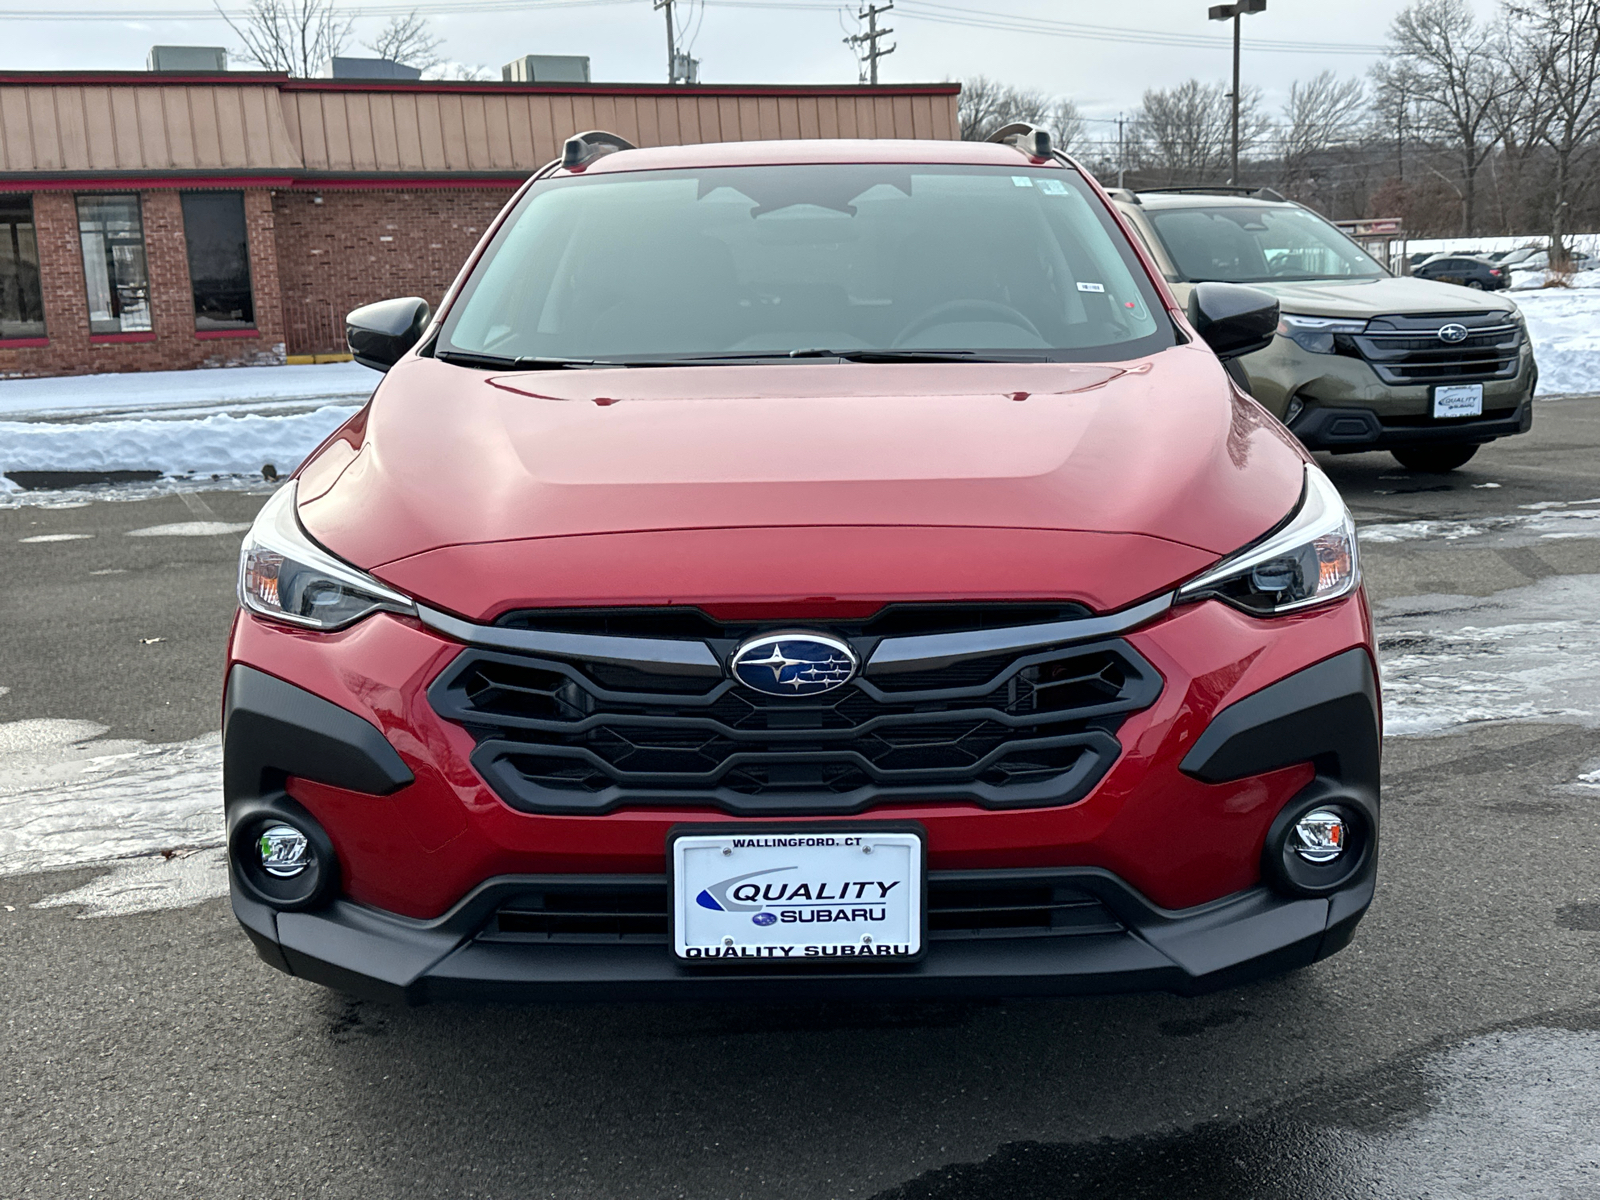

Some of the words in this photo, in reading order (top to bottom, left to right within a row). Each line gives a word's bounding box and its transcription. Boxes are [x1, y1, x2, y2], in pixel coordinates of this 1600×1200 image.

[844, 837, 862, 846] CT
[733, 881, 901, 902] QUALITY
[780, 908, 886, 923] SUBARU
[685, 946, 795, 958] QUALITY
[804, 945, 909, 957] SUBARU
